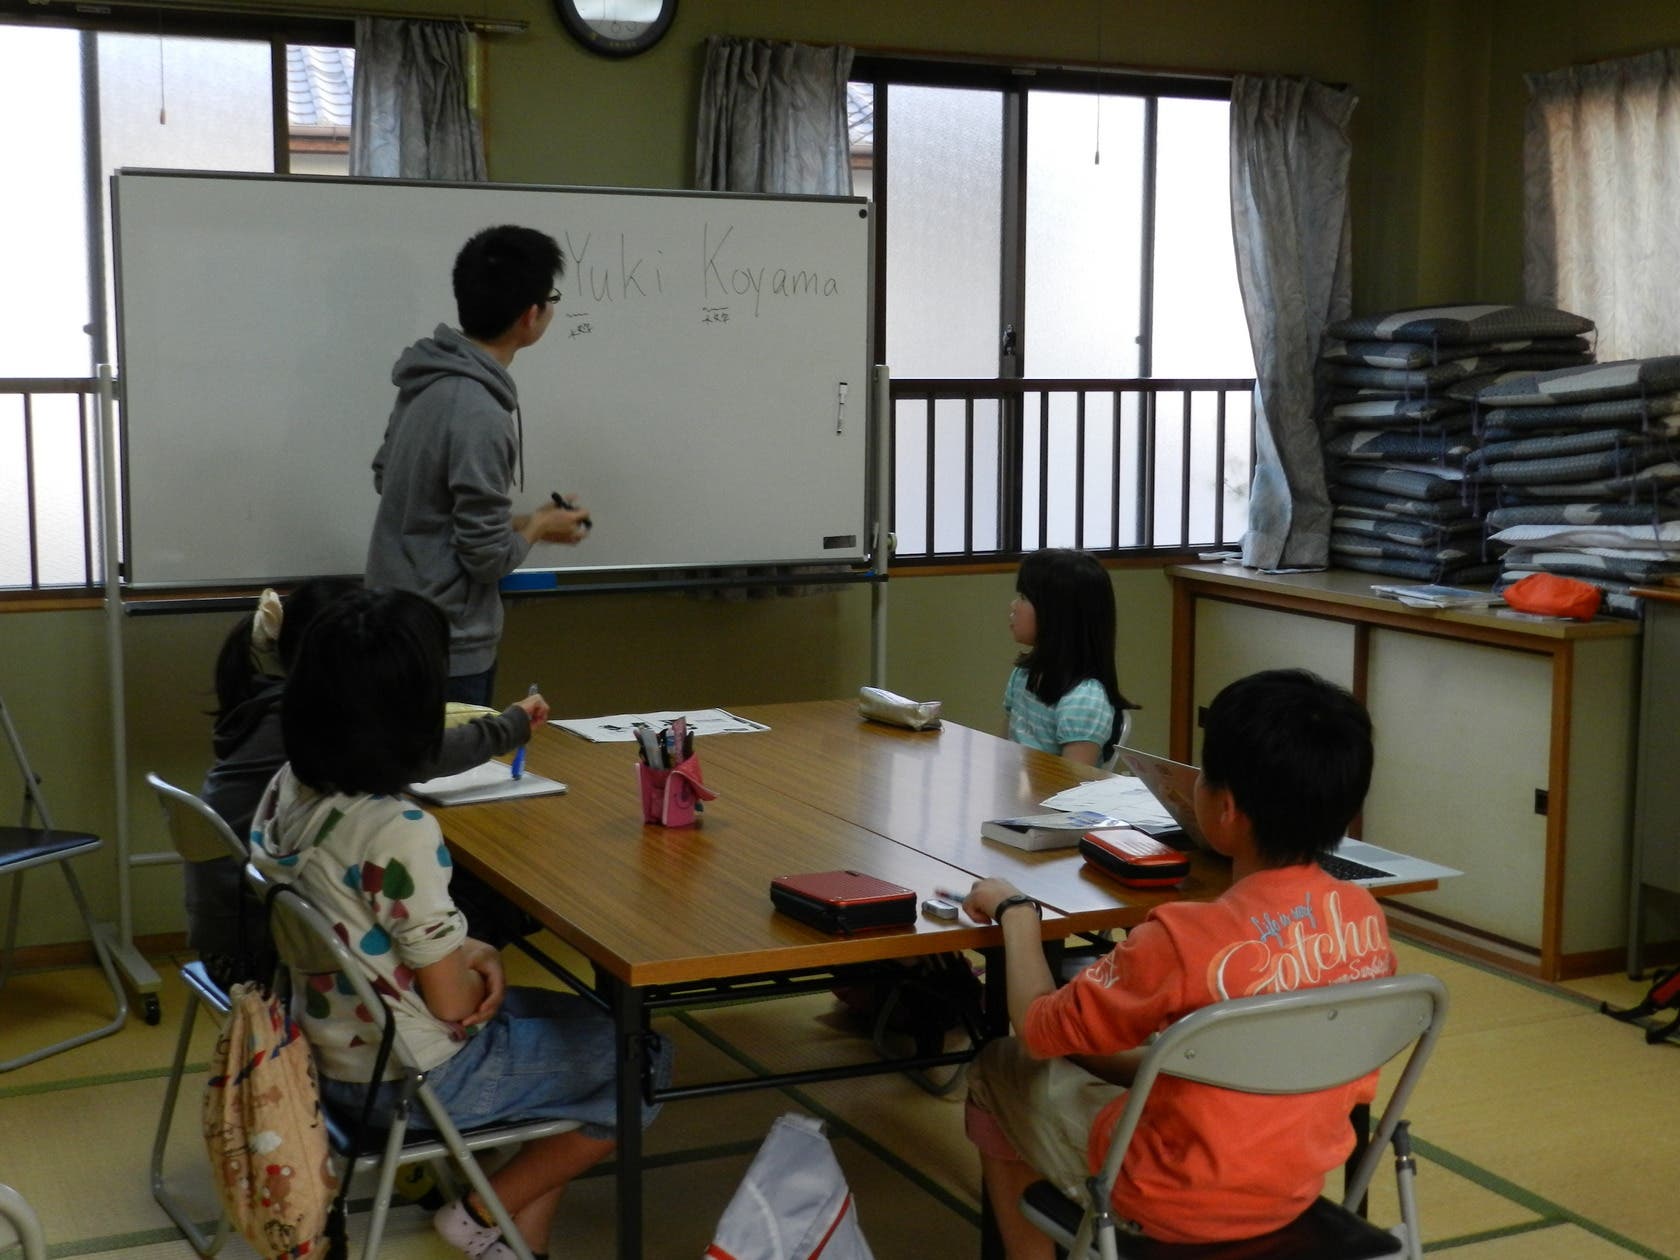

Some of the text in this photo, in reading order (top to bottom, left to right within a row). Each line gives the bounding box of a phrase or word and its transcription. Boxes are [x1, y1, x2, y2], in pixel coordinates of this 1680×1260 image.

[564, 222, 839, 318] Yuki Koyama
[1210, 889, 1387, 1001] Gotcha
